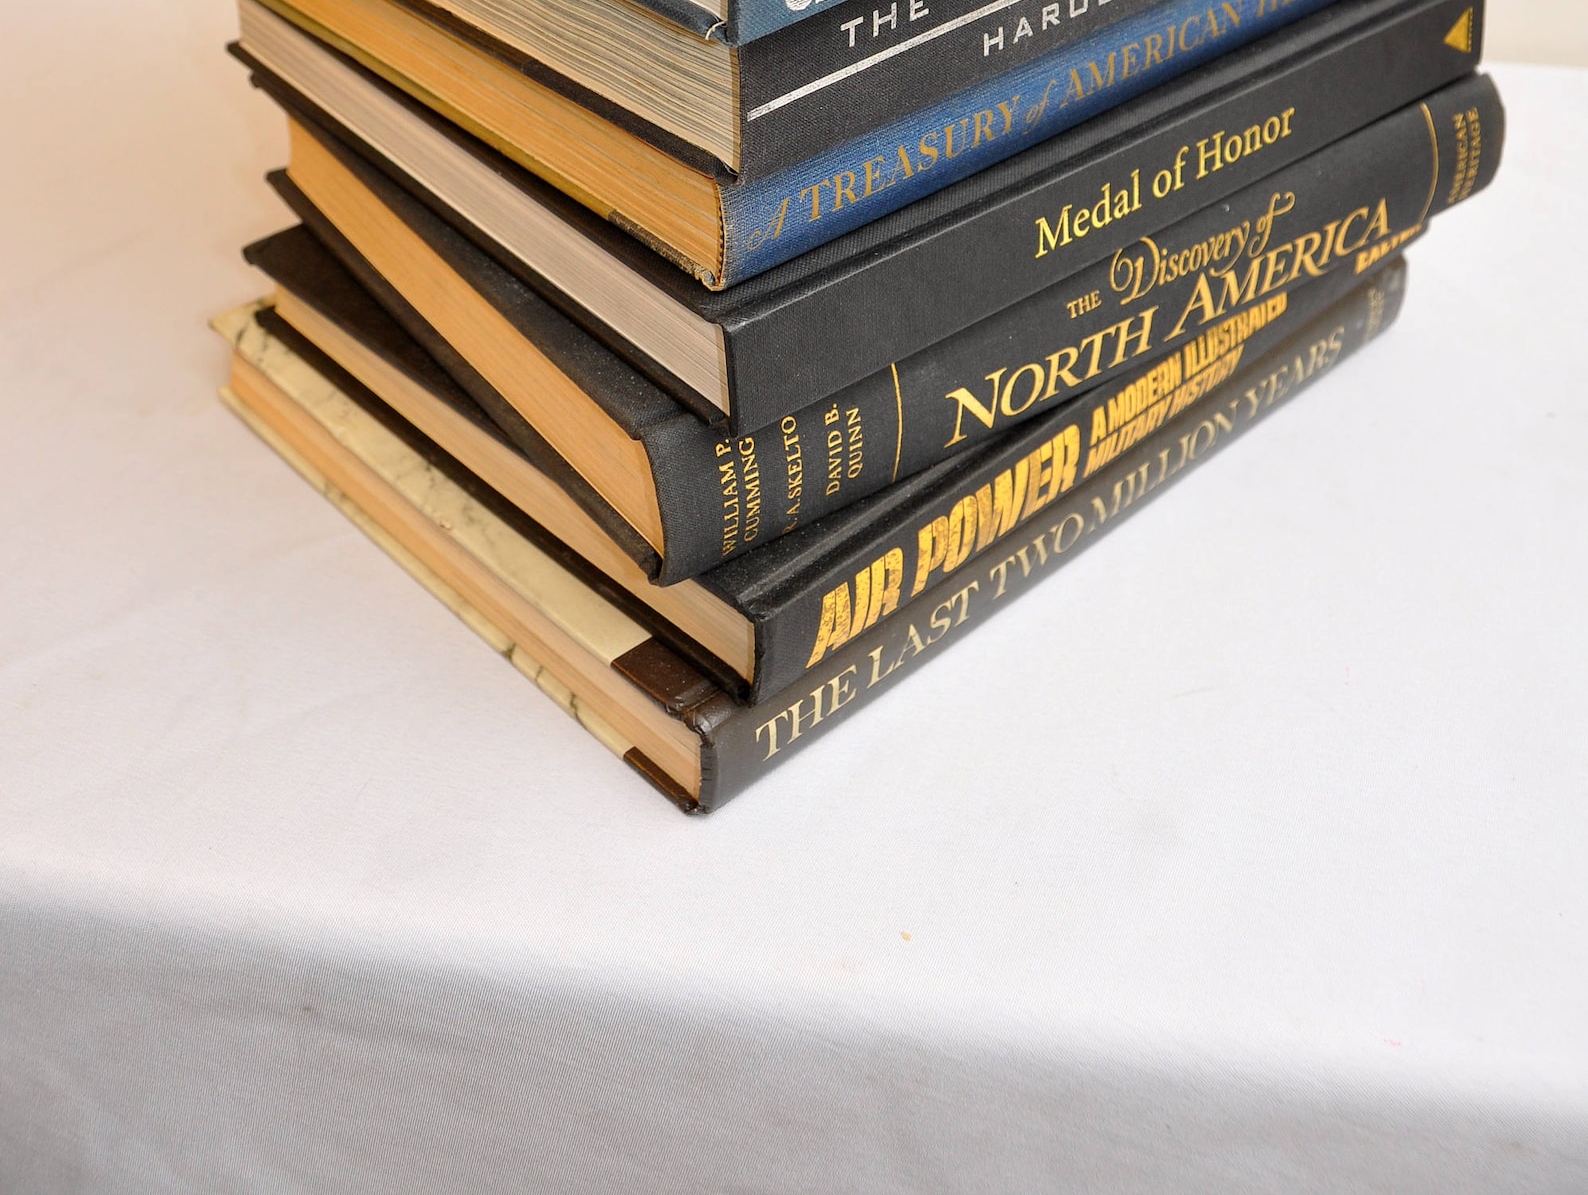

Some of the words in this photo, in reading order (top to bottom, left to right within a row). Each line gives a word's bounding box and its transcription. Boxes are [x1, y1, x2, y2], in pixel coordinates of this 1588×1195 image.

[747, 196, 789, 251] A
[800, 95, 1020, 222] TREASURY
[1022, 79, 1058, 136] of
[1035, 169, 1142, 258] Medal
[1152, 146, 1189, 199] of
[1196, 107, 1295, 180] Honor
[1066, 289, 1102, 319] THE
[1110, 220, 1250, 305] Discovery
[1248, 191, 1296, 258] of
[944, 305, 1159, 448] NORTH
[1163, 197, 1391, 343] AMERICA
[1090, 405, 1108, 446] A
[1107, 351, 1182, 433] MODERN
[1182, 291, 1288, 382] ILLUSTRATED
[715, 438, 732, 457] P.
[780, 415, 803, 499] SKELTO
[824, 403, 840, 426] B.
[825, 430, 843, 496] DAVID
[846, 407, 863, 479] QUINN
[1083, 396, 1172, 479] MILITARY
[1167, 343, 1245, 420] HISTORY
[719, 461, 739, 558] WILLIAM
[738, 436, 760, 542] CUMMING
[755, 665, 858, 762] THE
[867, 581, 979, 690] LAST
[989, 512, 1084, 601] TWO
[1089, 399, 1240, 530] MILLION
[1246, 326, 1345, 419] YEARS
[805, 547, 904, 669] AIR
[911, 424, 1081, 598] POWER
